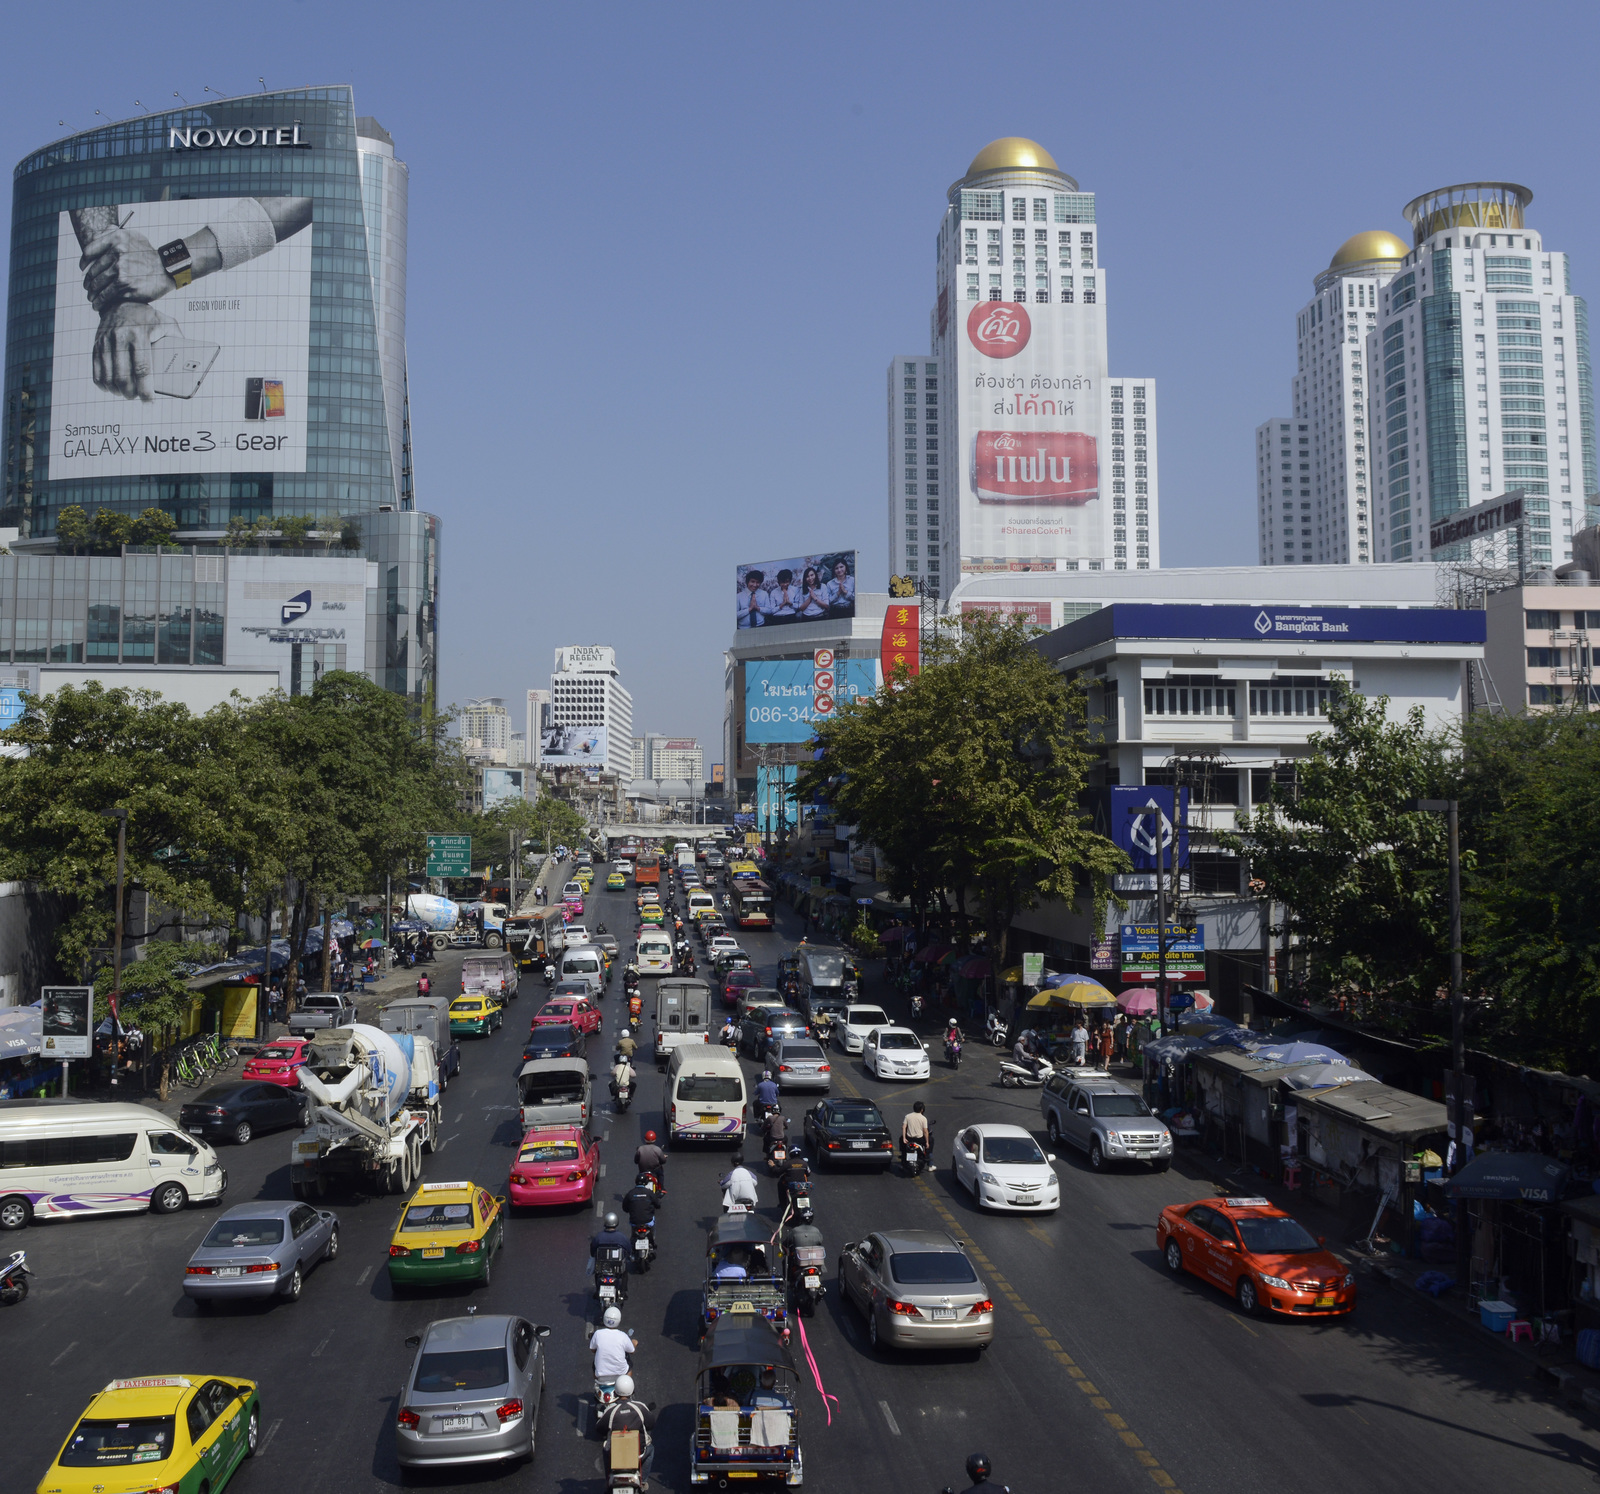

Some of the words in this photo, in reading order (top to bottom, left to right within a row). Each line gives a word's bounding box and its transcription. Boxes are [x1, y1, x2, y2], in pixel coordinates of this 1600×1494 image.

[169, 119, 310, 149] NOVOTEL
[188, 301, 209, 311] DESIGN
[211, 300, 226, 310] YOUR
[228, 299, 240, 310] LIFE
[975, 373, 1024, 389] ต้องซ่า
[1030, 374, 1092, 390] ต้องกล้า
[65, 423, 121, 439] Samsung
[63, 437, 139, 458] GALAXY
[235, 433, 288, 452] Gear
[995, 448, 1072, 484] แฟน
[1478, 506, 1502, 532] CITY
[1001, 526, 1072, 535] #ShareaCokeTH
[1275, 621, 1320, 633] Bangkok
[1322, 622, 1349, 632] Bank
[573, 647, 600, 655] INDRA
[1134, 926, 1170, 935] Yoskan
[1140, 952, 1180, 961] Aphrdite
[1181, 951, 1195, 959] Inn
[6, 1038, 27, 1048] VISA
[1519, 1188, 1549, 1200] VISA
[123, 1379, 167, 1388] TAXI-METER
[457, 1417, 469, 1425] 891
